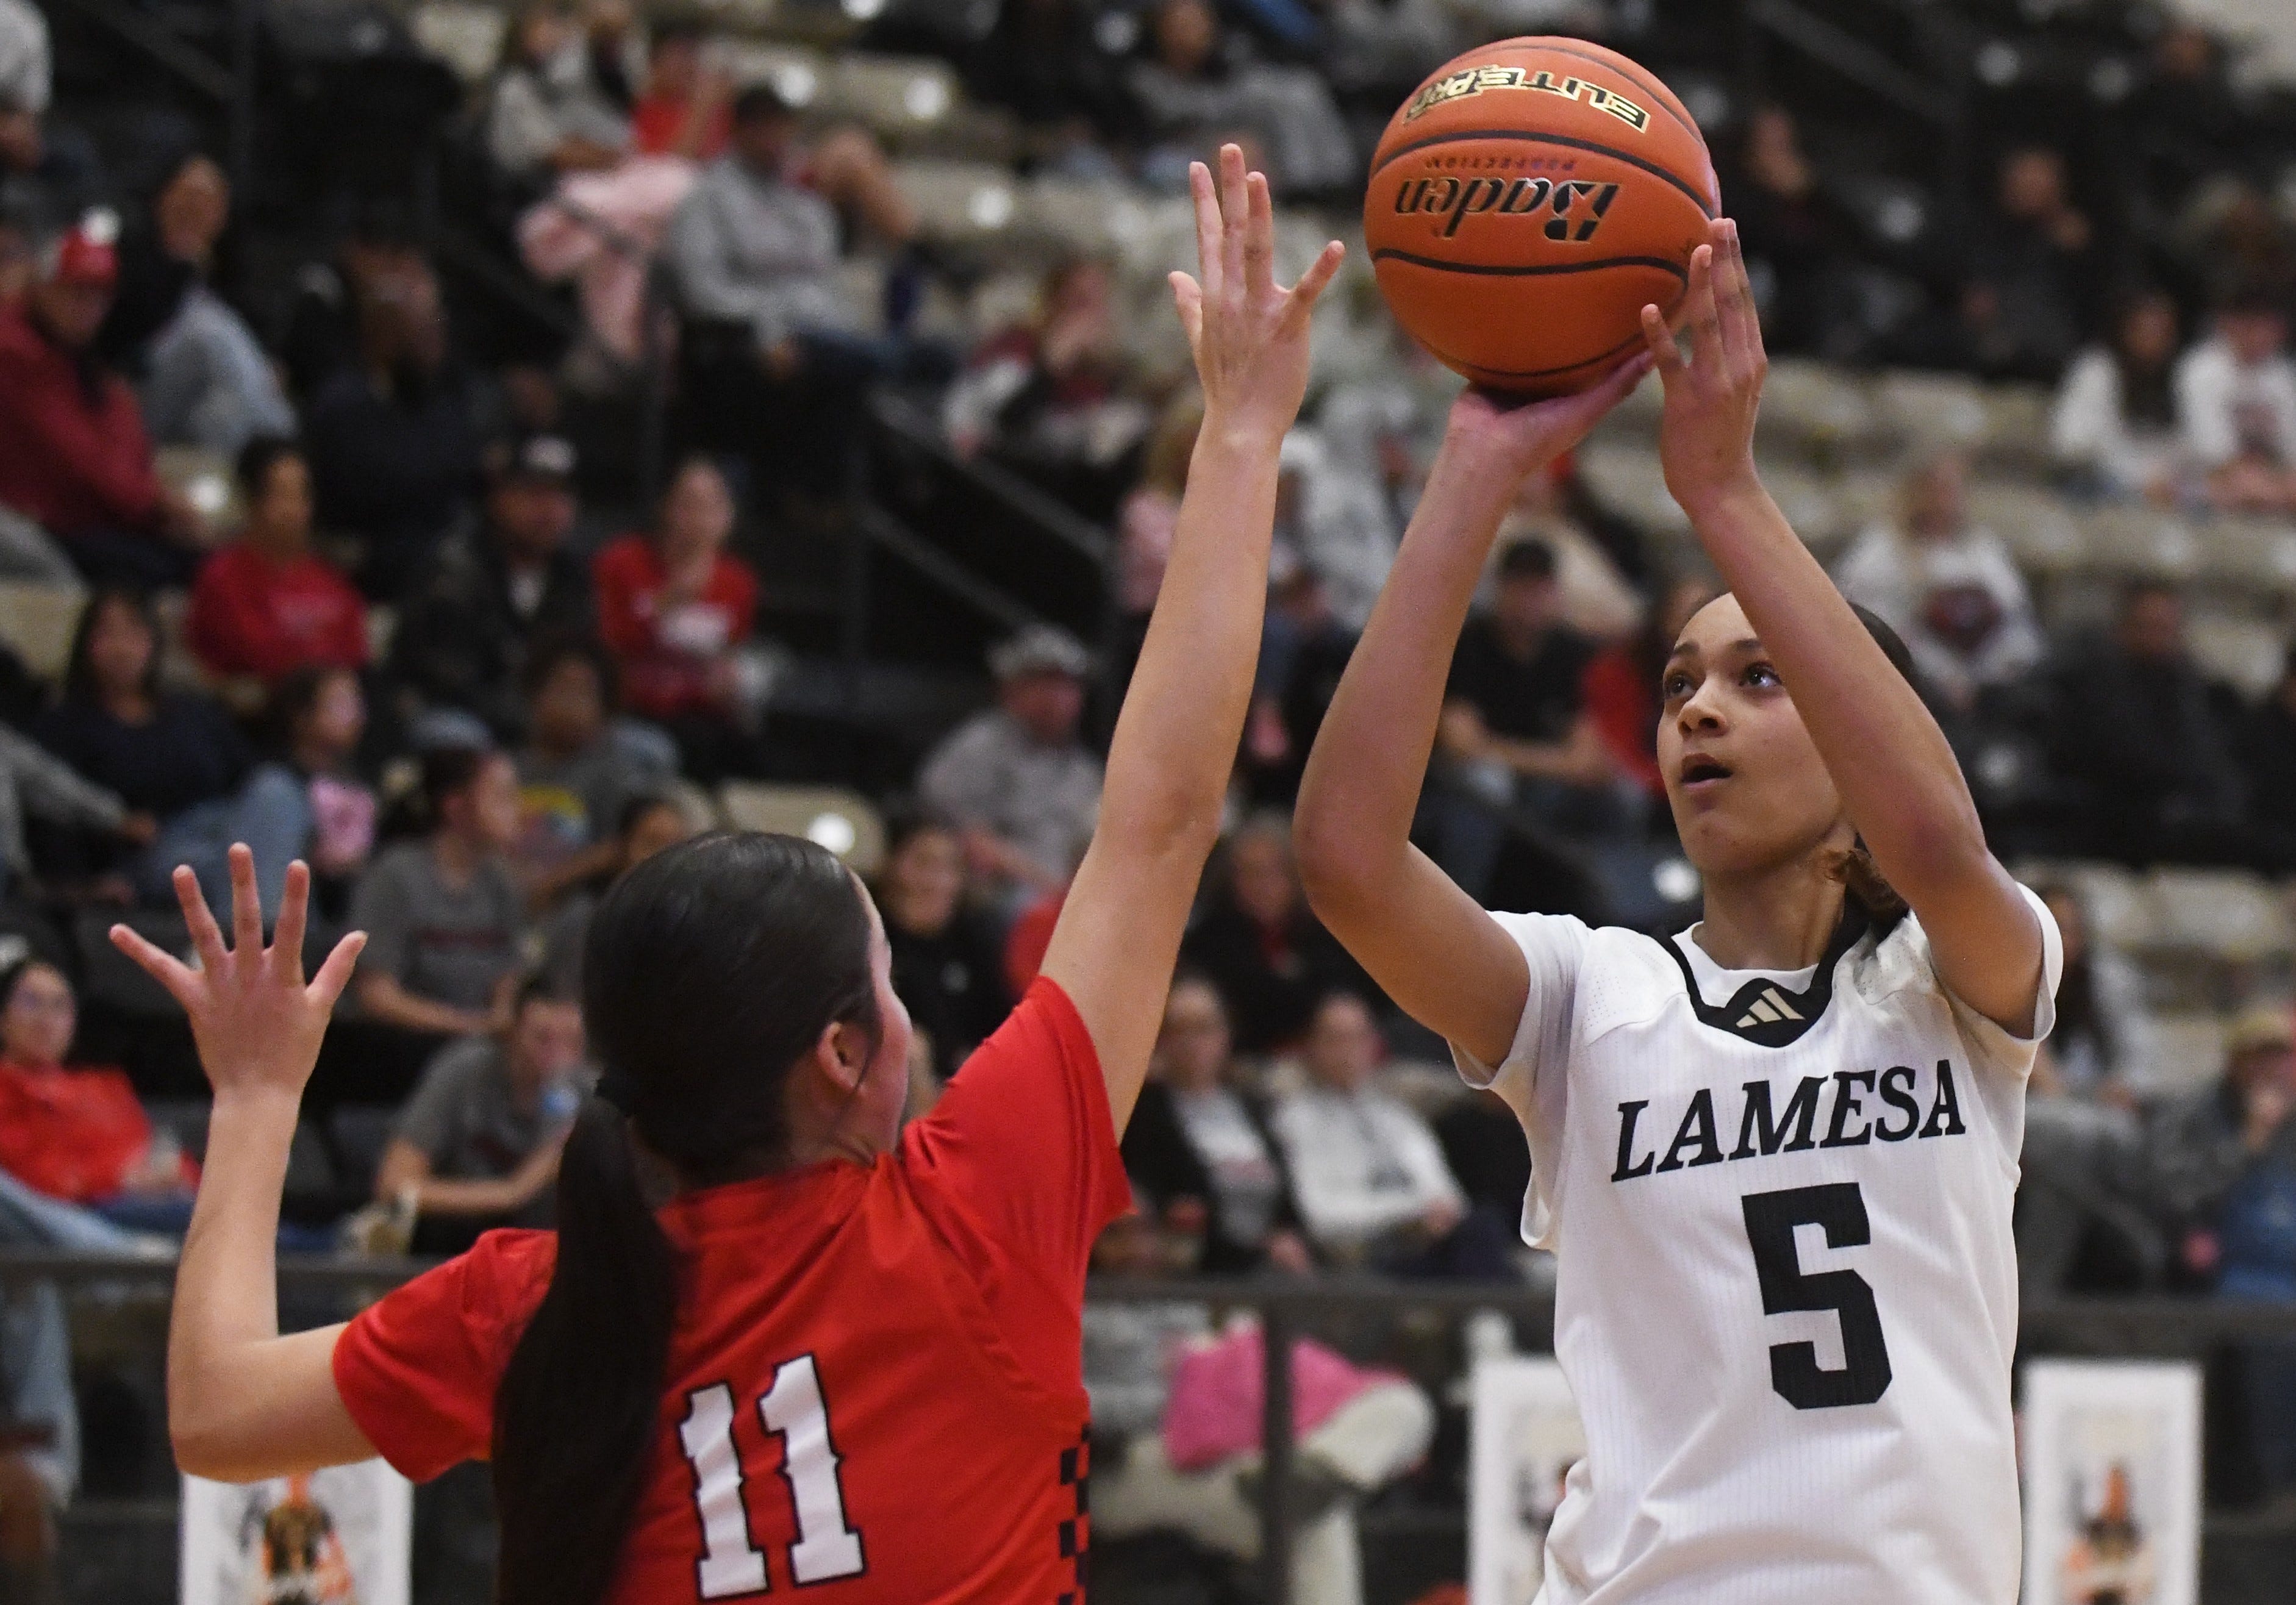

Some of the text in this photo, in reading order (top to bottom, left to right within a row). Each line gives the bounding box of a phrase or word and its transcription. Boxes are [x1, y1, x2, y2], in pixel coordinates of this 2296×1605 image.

[1476, 64, 1651, 134] ELITE
[1393, 176, 1620, 244] Baden
[1611, 1059, 1966, 1182] LAMESA
[1741, 1182, 1892, 1410] 5
[679, 1352, 868, 1602] 11
